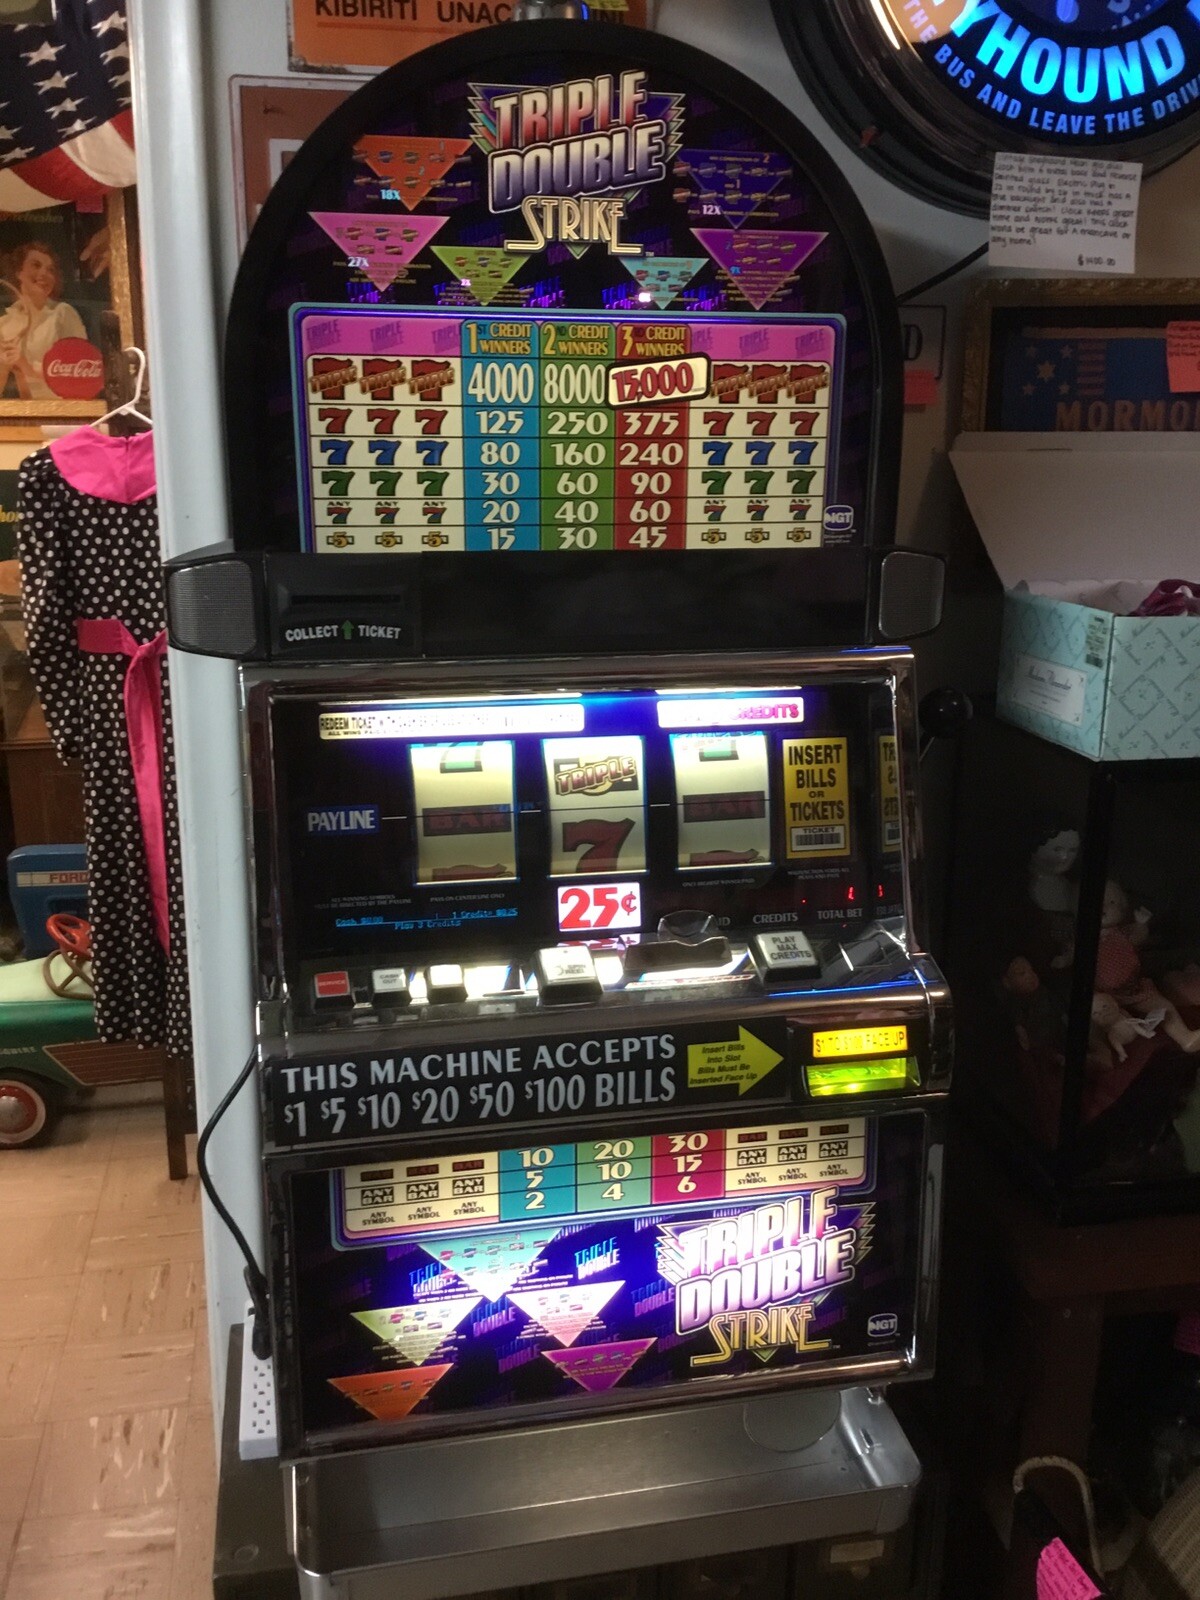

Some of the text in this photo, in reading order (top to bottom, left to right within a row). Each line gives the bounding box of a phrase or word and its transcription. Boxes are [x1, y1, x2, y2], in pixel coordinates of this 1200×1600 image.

[315, 0, 512, 24] KIBIRITI UNAC
[933, 0, 1186, 103] YHOUND
[903, 0, 1200, 134] THE BUS AND LEAVE THE DRIV
[493, 70, 647, 148] TRIPLE
[489, 121, 666, 212] DOUBLE
[702, 204, 722, 216] 12X
[503, 197, 645, 256] STRIKE
[489, 323, 532, 338] CREDIT
[568, 325, 609, 339] CREDIT
[645, 326, 687, 340] CREDIT
[479, 340, 686, 356] WINNERS WINNERS WINNERS
[468, 361, 534, 404] 4000
[544, 363, 606, 404] 8000
[612, 362, 694, 402] 15,000
[476, 411, 680, 435] 125 250 375
[480, 441, 683, 466] 80 160 240
[482, 471, 672, 495] 30 60 90
[482, 501, 520, 522] 20
[554, 501, 599, 523] 40
[629, 501, 671, 522] 60
[487, 527, 667, 549] 15 30 45
[285, 624, 401, 642] COLLECT TICKET
[789, 745, 843, 766] INSERT
[556, 757, 638, 796] TRIPLE
[796, 769, 837, 788] BILLS
[808, 790, 825, 799] OR
[307, 809, 376, 832] PAYLINE
[790, 801, 845, 822] TICKETS
[802, 826, 837, 834] TICKET
[562, 818, 636, 872] 7
[559, 887, 638, 929] 25¢
[753, 912, 798, 924] CREDITS
[817, 908, 863, 920] TOTAL BET
[427, 920, 461, 929] Credits
[772, 936, 795, 944] PLAY
[777, 943, 797, 951] MAX
[770, 951, 812, 960] CREDITS
[318, 980, 346, 988] SERVICE
[702, 1044, 745, 1054] Insert Bills
[893, 1031, 905, 1046] UP
[281, 1032, 675, 1094] THIS MACHINE ACCEPTS
[697, 1063, 750, 1075] Bills Must Be
[724, 1054, 741, 1062] Slot
[689, 1076, 723, 1084] Inserted
[745, 1073, 758, 1081] Up
[284, 1066, 676, 1137] $1 $5 $10 $20 $50 $100 BILLS
[518, 1132, 709, 1168] 10 20 30
[362, 1142, 848, 1197] ANY ANY ANY 5 10 15 ANY ANY ANY
[363, 1148, 848, 1204] BAR BAR BAR BAR BAR BAR
[362, 1168, 849, 1226] SYMBOL SYMBOL SYMBOL SYMBOL SYMBOL SYMBOL
[370, 1211, 387, 1219] ANY
[416, 1206, 432, 1214] ANY
[462, 1201, 478, 1209] ANY
[525, 1192, 545, 1211] 2
[602, 1183, 625, 1201] 4
[677, 1175, 697, 1194] 6
[786, 1167, 801, 1175] ANY
[827, 1163, 841, 1171] ANY
[680, 1185, 838, 1277] TRIPLE
[574, 1236, 617, 1266] TRIPLE
[577, 1249, 620, 1280] DOUBLE
[676, 1229, 856, 1335] DOUBLE
[691, 1303, 832, 1367] STRIKE
